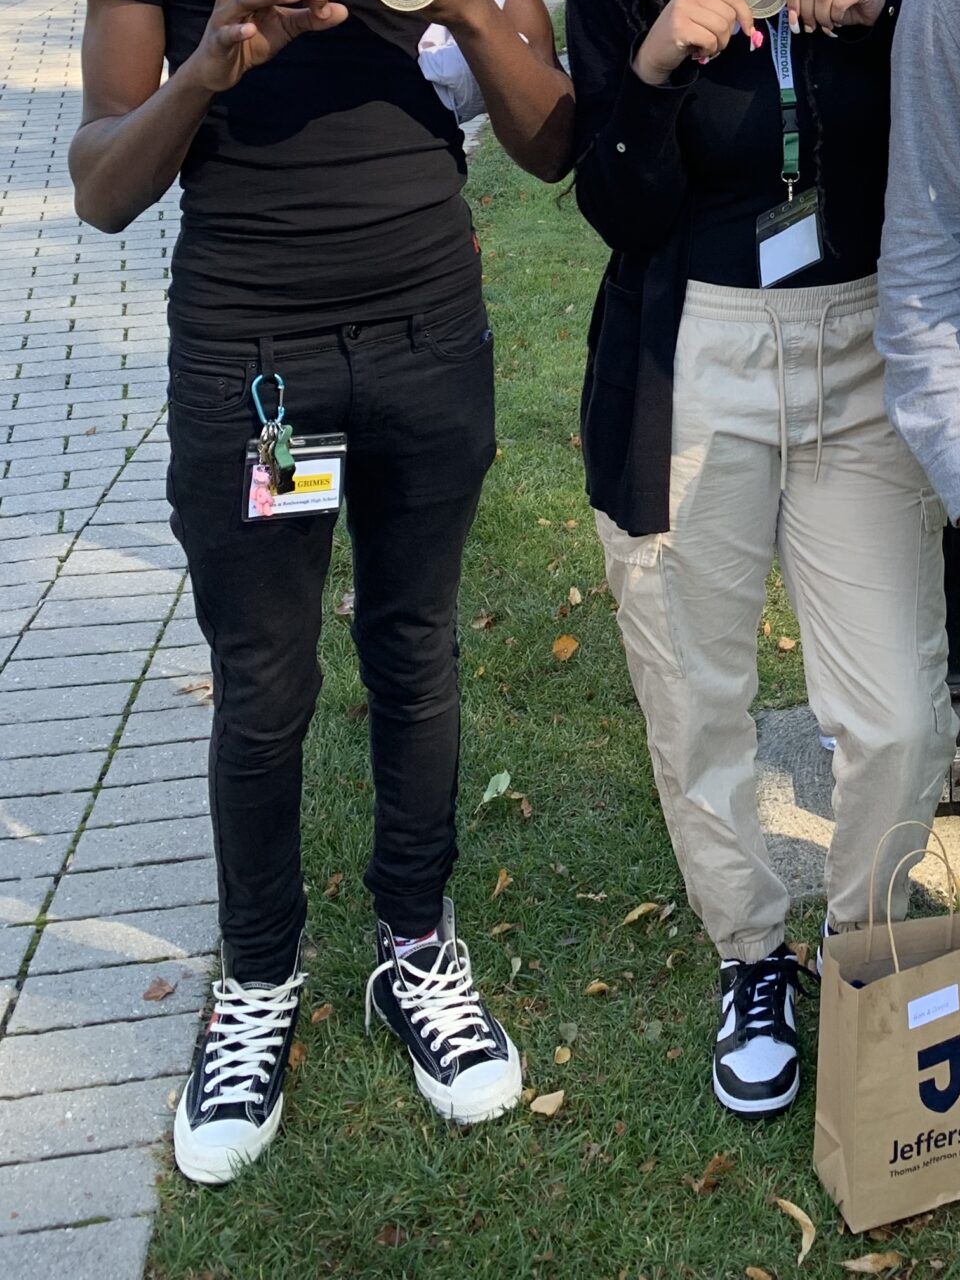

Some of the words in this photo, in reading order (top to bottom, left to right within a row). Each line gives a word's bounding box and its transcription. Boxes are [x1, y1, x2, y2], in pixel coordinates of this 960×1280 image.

[297, 478, 330, 488] GRIMES
[889, 1164, 920, 1178] Thomas
[921, 1151, 957, 1168] Jefferson
